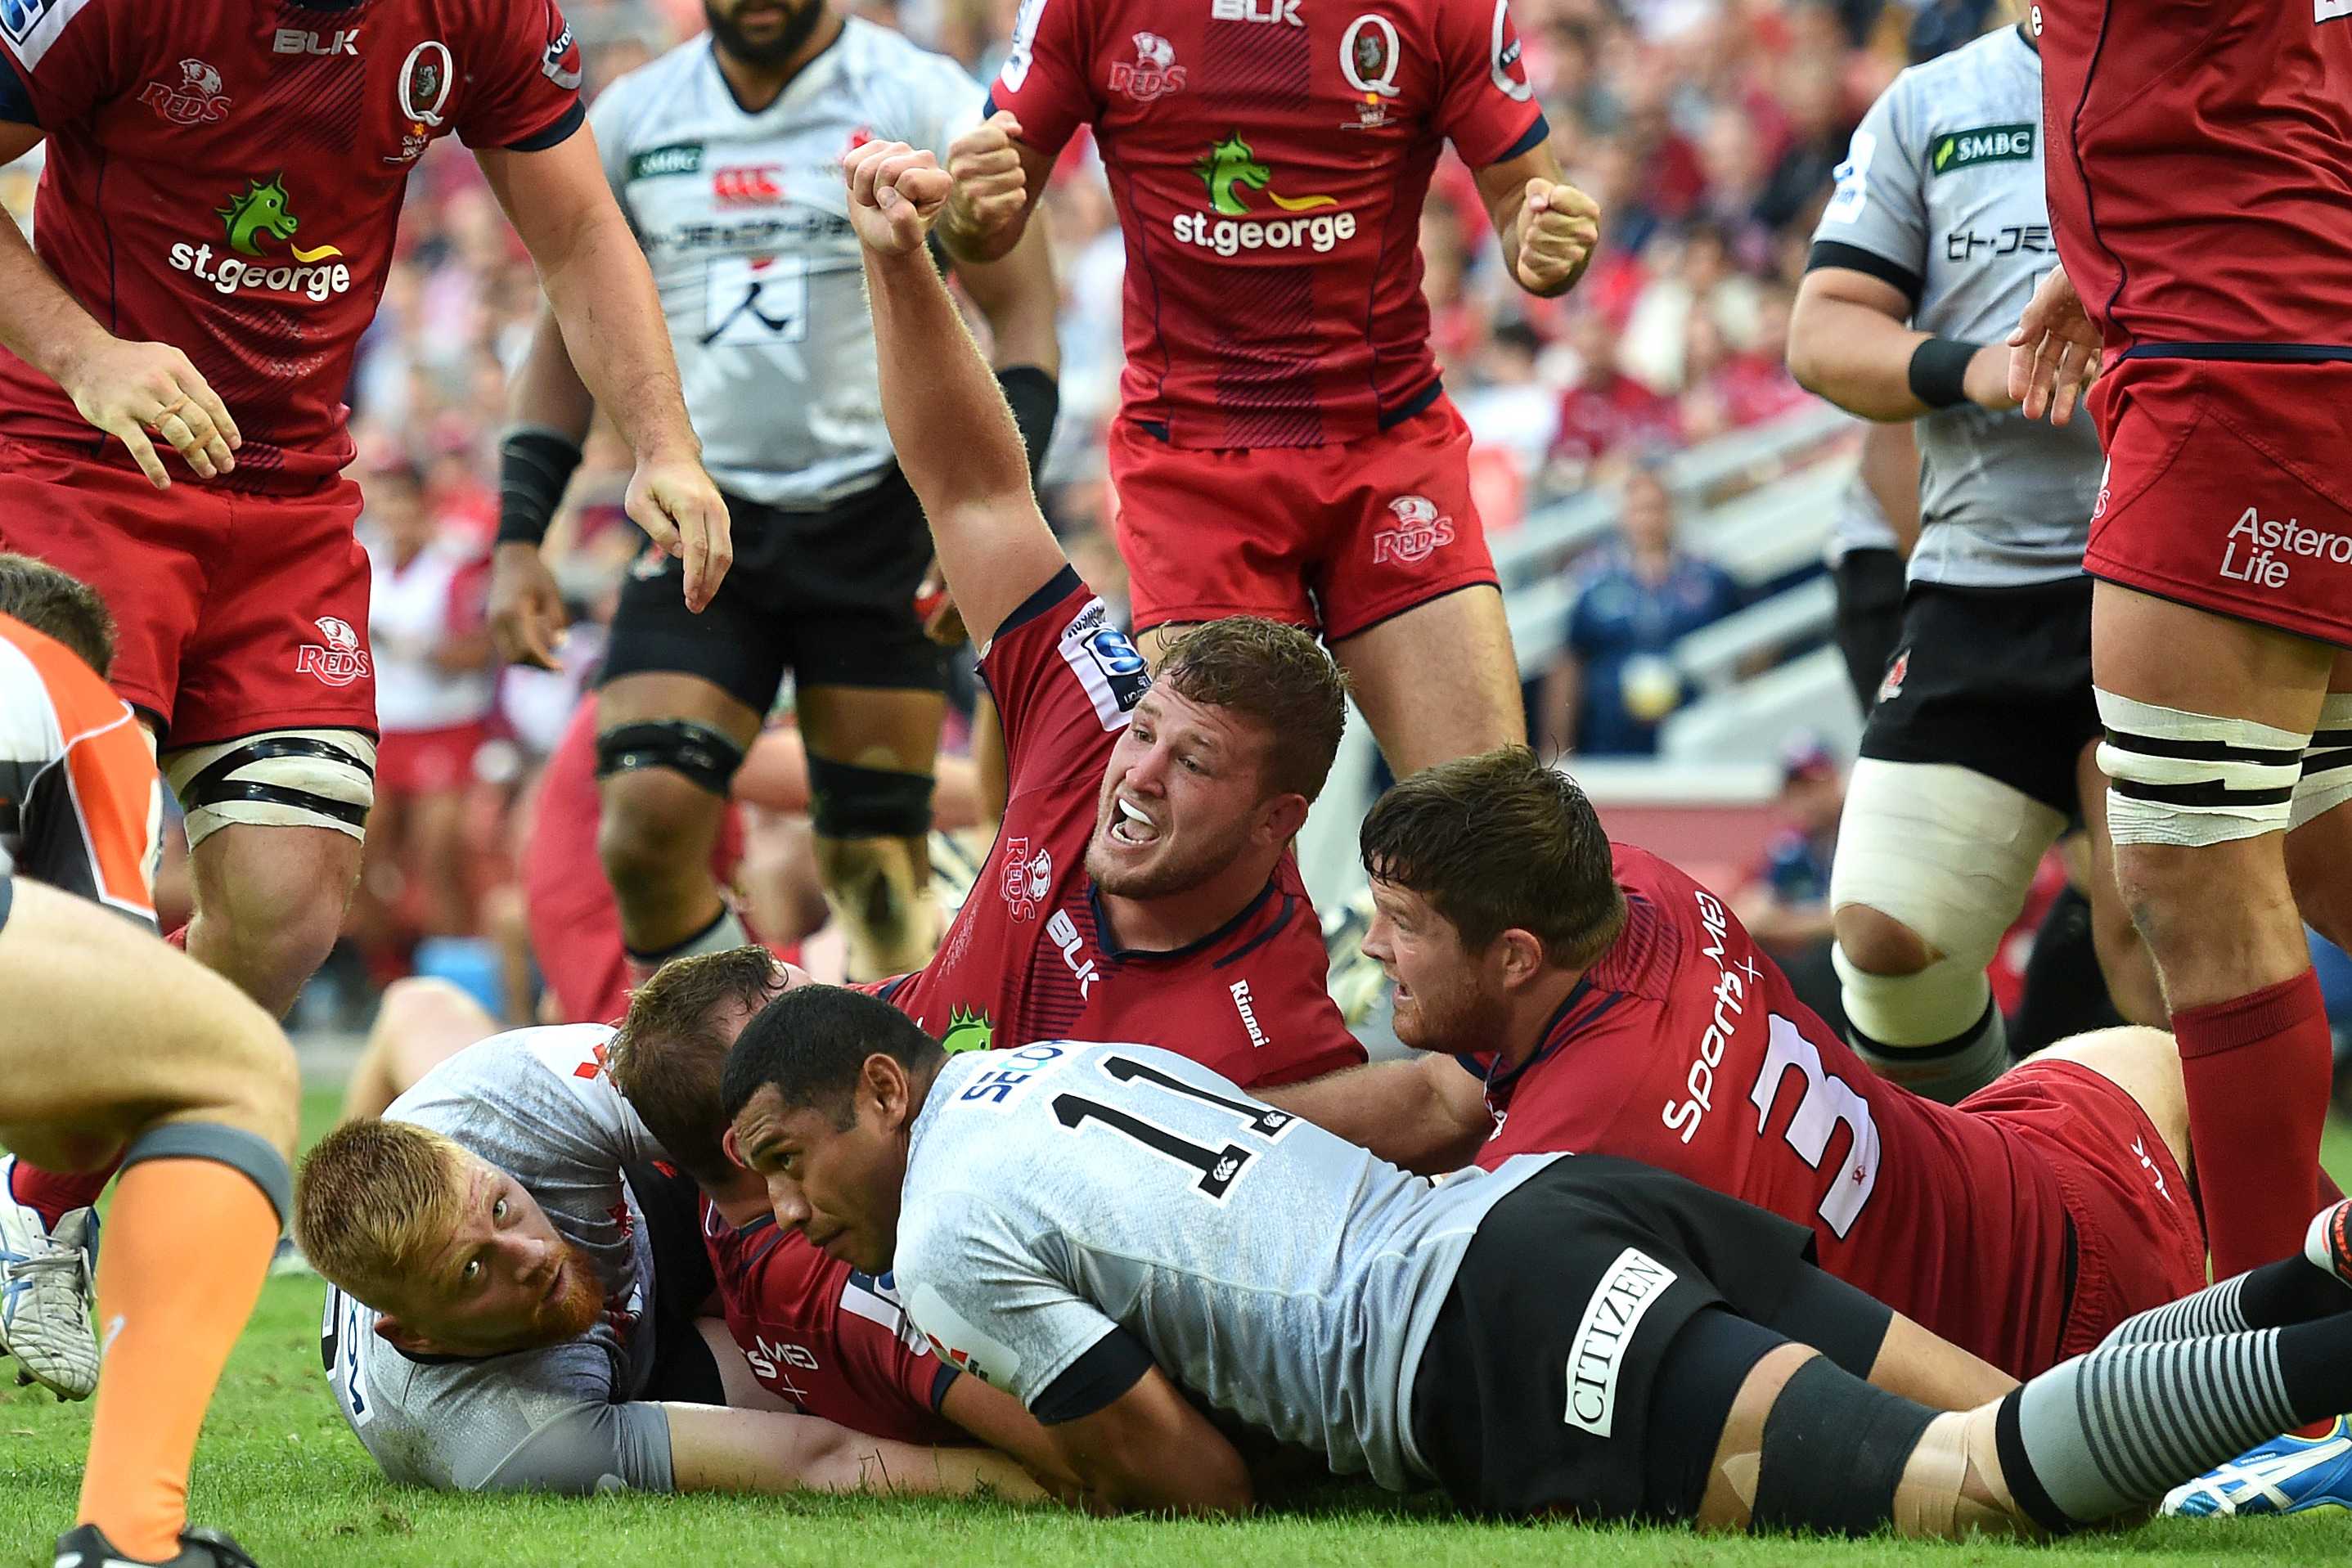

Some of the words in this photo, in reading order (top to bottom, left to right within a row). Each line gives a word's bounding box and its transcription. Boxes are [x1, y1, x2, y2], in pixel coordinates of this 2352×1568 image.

[1211, 0, 1304, 27] BLK
[272, 28, 360, 56] BLK
[1339, 14, 1401, 97] Q
[137, 82, 232, 125] REDS
[398, 41, 453, 127] Q
[1107, 56, 1187, 101] REDS
[1957, 131, 2030, 162] SMBC
[1173, 213, 1356, 256] st.george
[1948, 227, 2057, 260] ヒト・コミ
[169, 243, 350, 301] st.george
[1373, 514, 1455, 564] REDS
[2219, 507, 2352, 564] Astero
[2219, 542, 2289, 588] Life
[296, 645, 371, 686] REDS
[1000, 837, 1036, 923] REDS
[1045, 908, 1101, 1001] BLK
[1229, 980, 1271, 1049] Rinnai
[1053, 1056, 1294, 1199] 11
[1751, 1013, 1881, 1240] 3
[1572, 1255, 1664, 1425] CITIZEN
